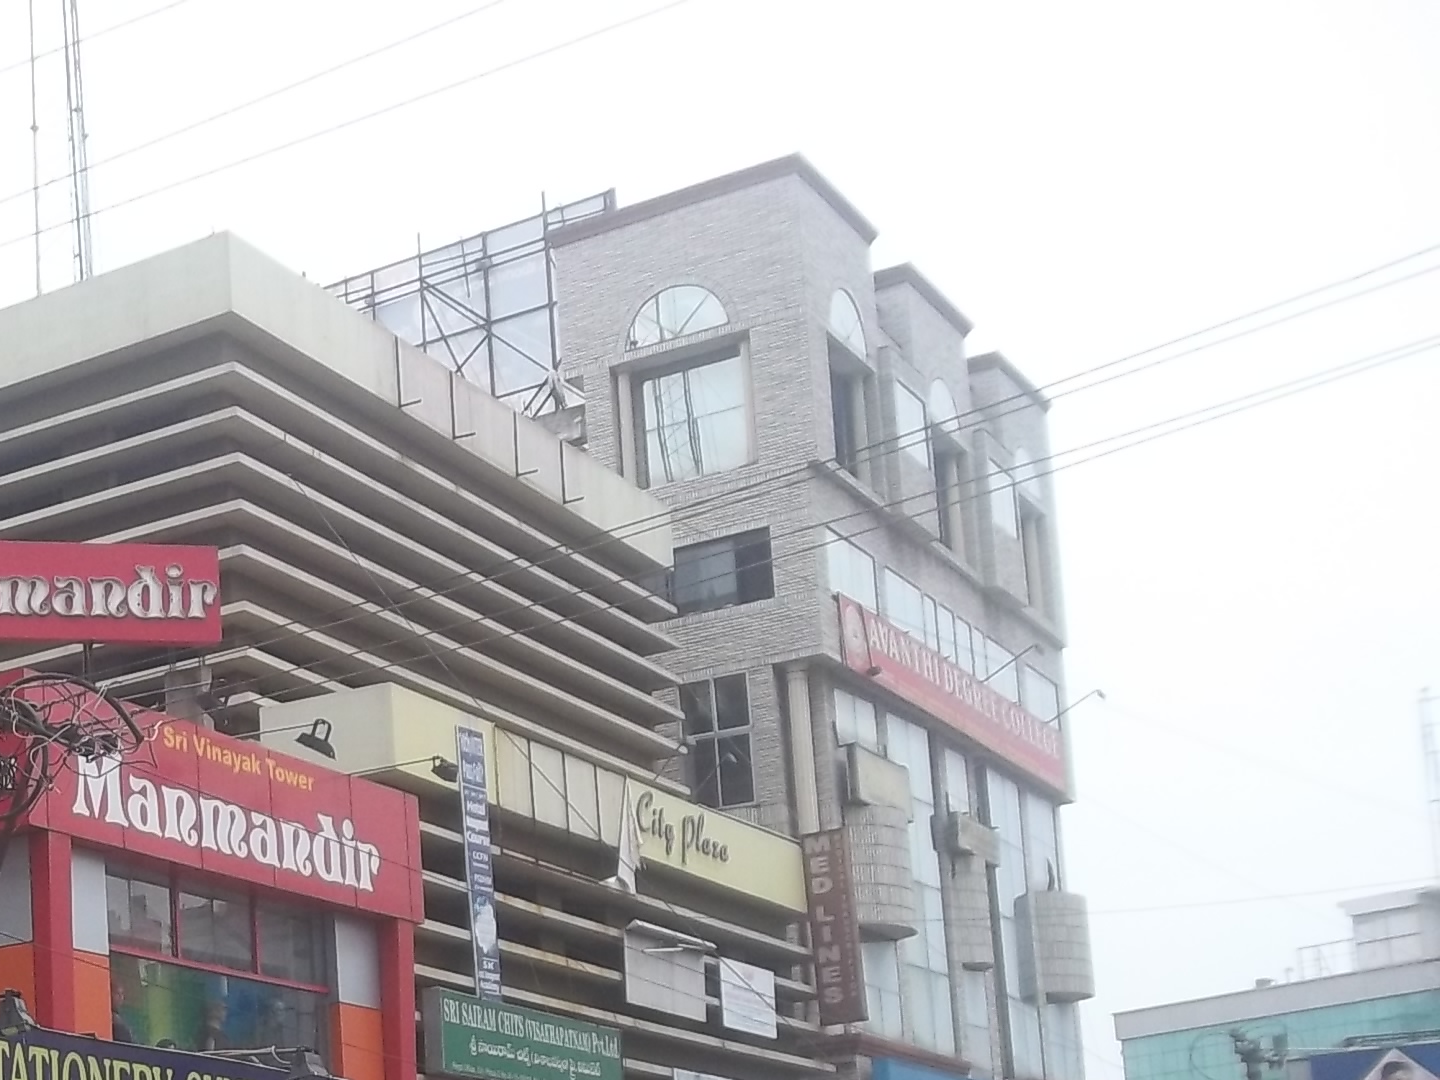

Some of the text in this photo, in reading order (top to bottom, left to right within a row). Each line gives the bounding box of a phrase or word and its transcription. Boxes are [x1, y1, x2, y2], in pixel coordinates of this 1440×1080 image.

[163, 725, 315, 792] Sri Vinayak Tower
[72, 752, 380, 892] Manmandir
[636, 791, 730, 866] City Plaza
[443, 998, 461, 1025] SRI
[461, 1002, 497, 1032] SAIRAM
[498, 1011, 524, 1038] CHITS
